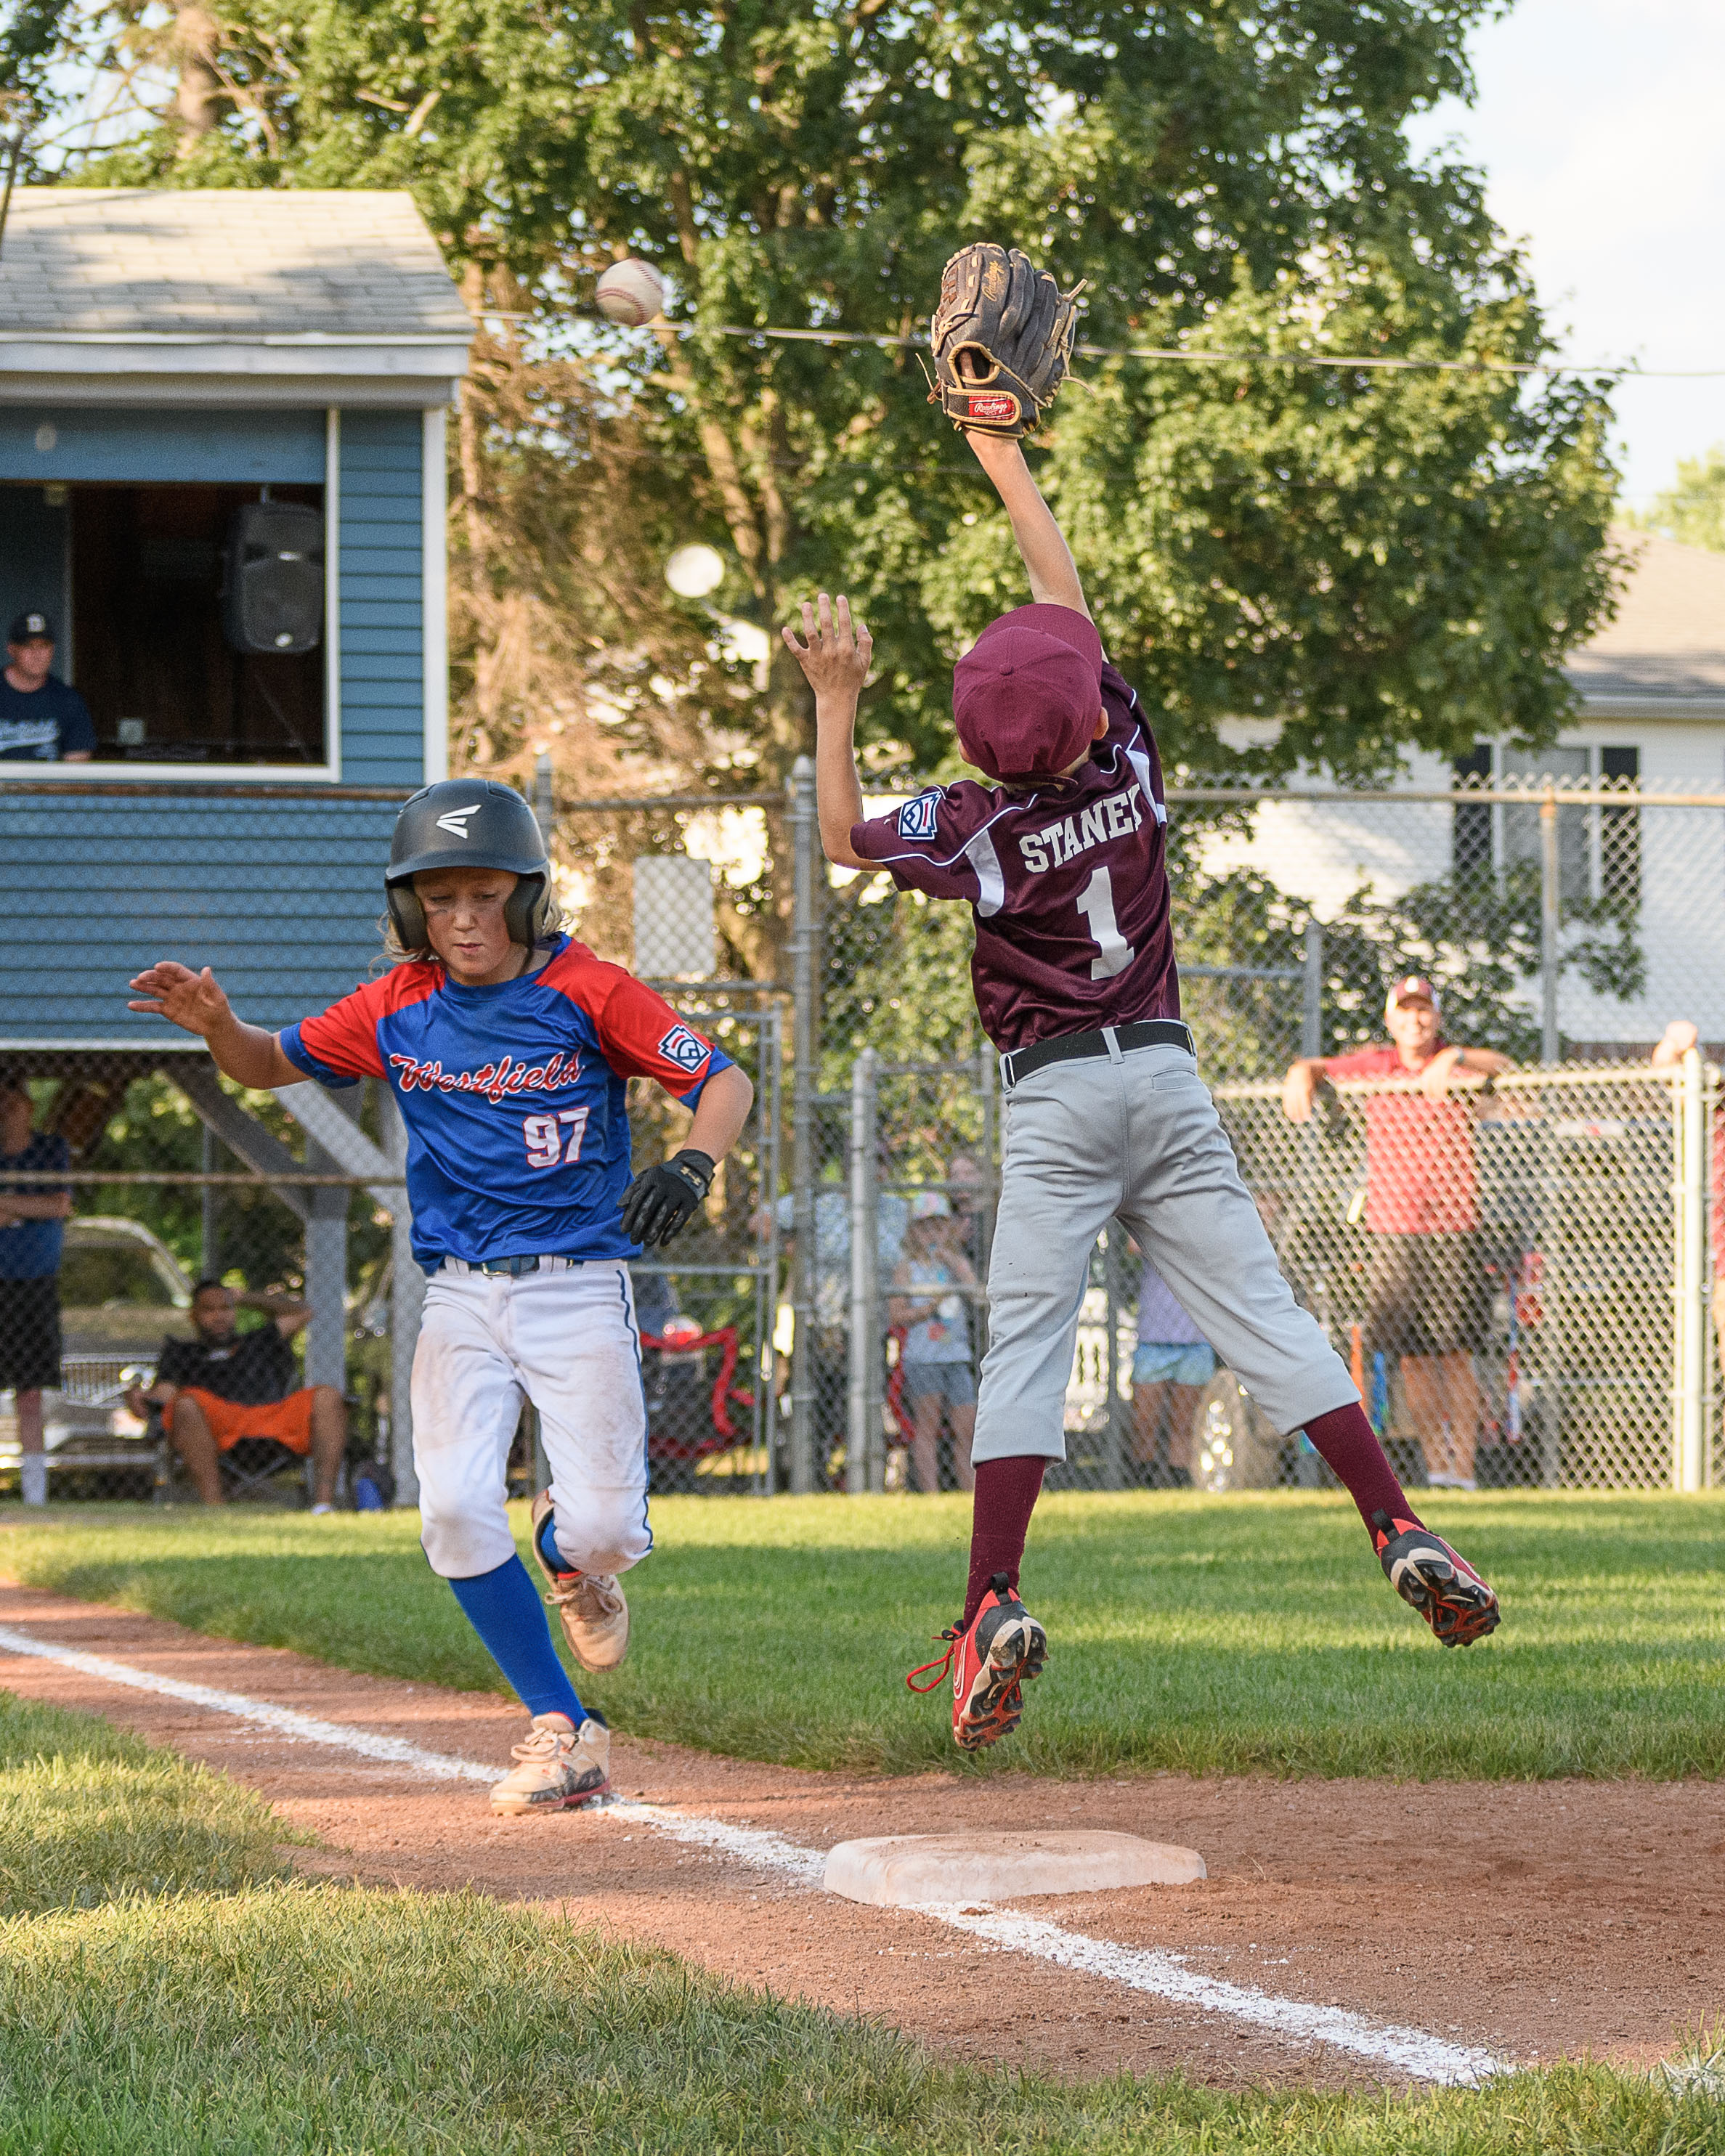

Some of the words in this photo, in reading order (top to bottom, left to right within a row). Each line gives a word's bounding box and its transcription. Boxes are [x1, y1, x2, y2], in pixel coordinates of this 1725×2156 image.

[974, 402, 1008, 414] Rawlings
[1076, 866, 1135, 980] 1
[389, 1047, 585, 1104] Westfield
[522, 1106, 590, 1169] 97
